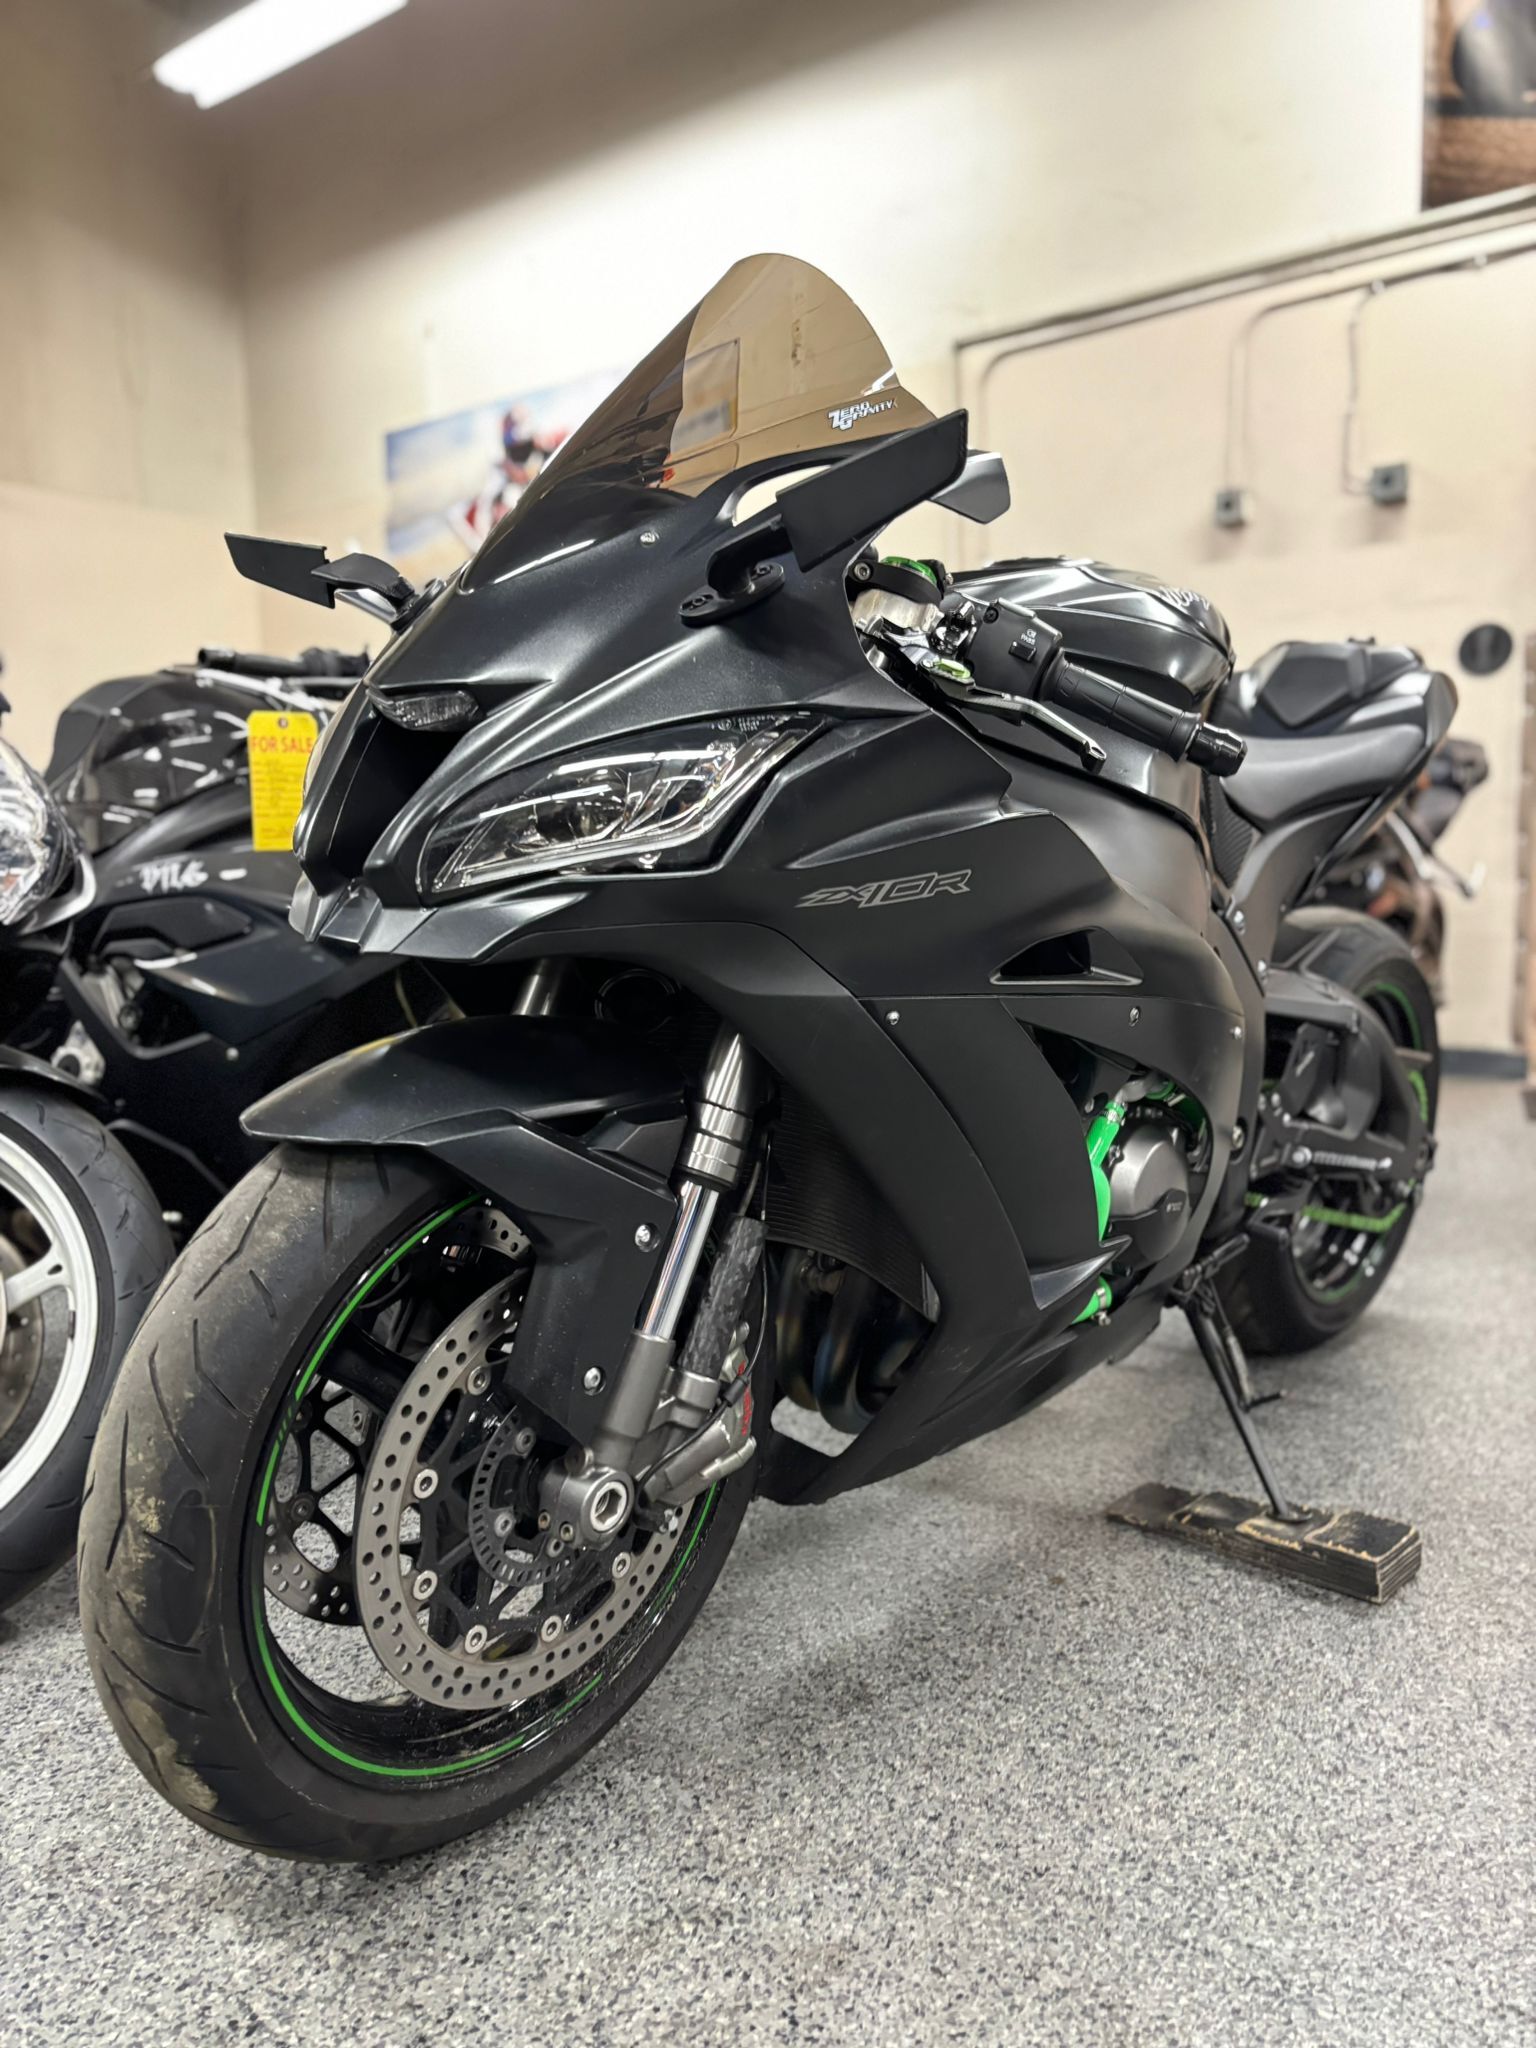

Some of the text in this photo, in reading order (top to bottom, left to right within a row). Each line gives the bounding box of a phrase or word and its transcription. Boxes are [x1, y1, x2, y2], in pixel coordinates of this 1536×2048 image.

[828, 401, 870, 429] ZERO
[840, 399, 895, 430] GRAVITY
[250, 736, 313, 753] FOR SALE
